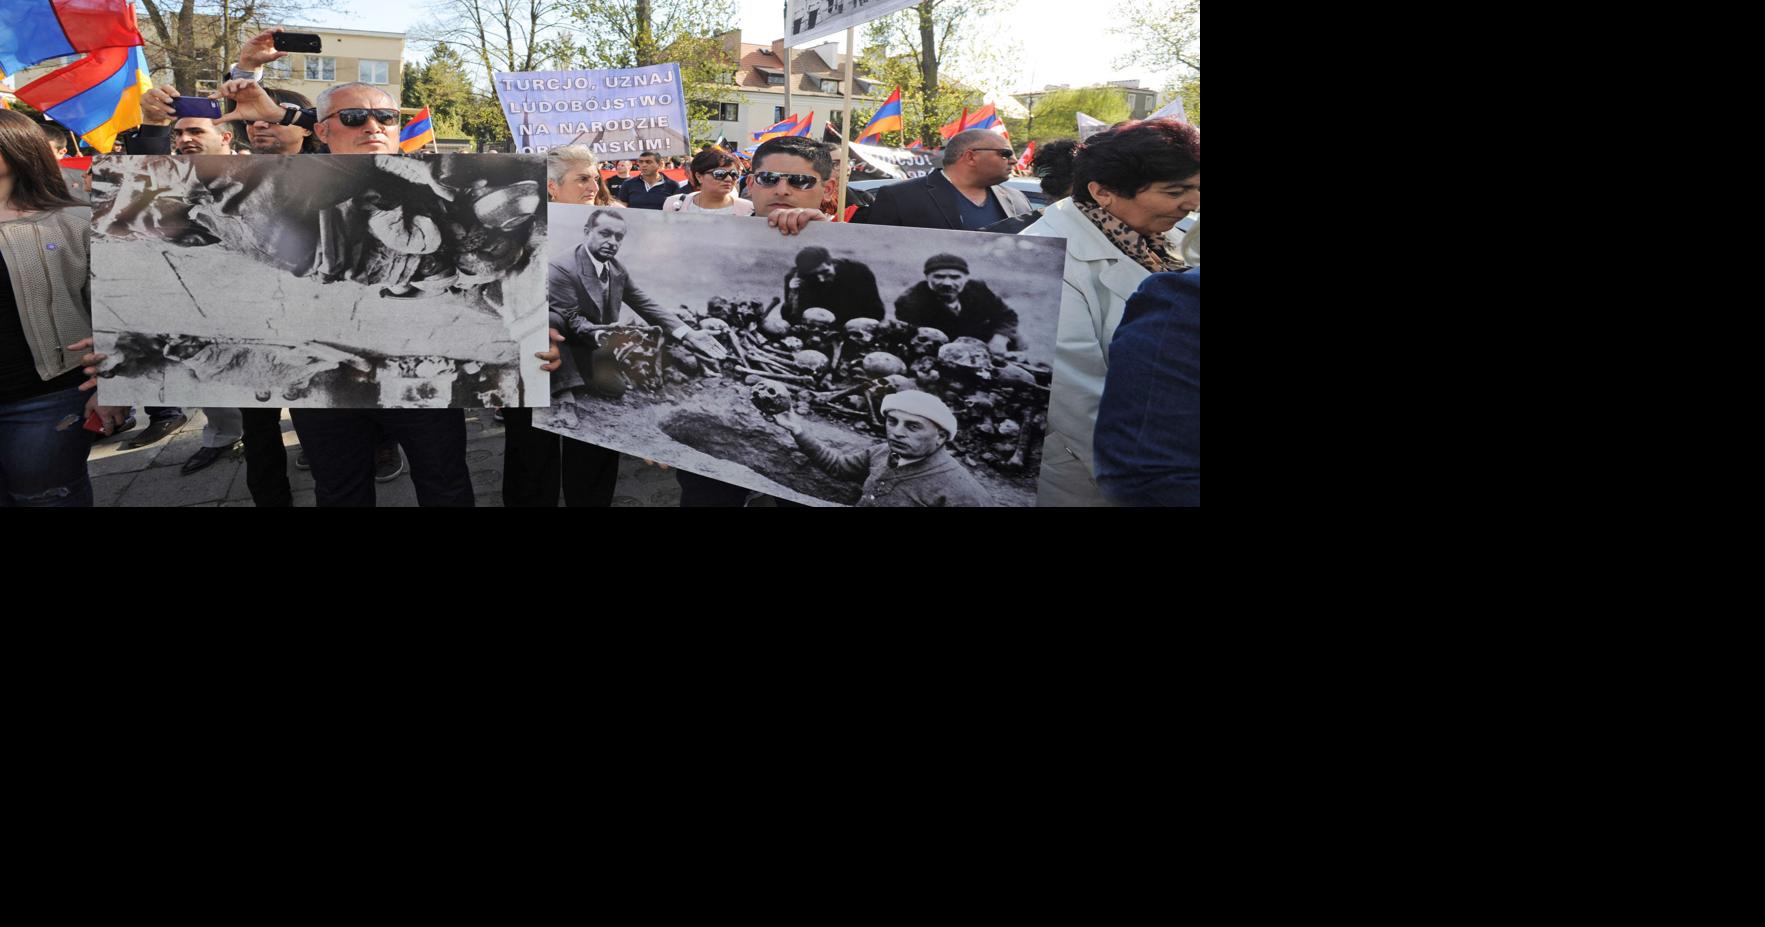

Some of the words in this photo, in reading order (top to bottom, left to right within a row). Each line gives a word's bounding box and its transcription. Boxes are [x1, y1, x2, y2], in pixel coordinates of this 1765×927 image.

[502, 77, 596, 92] TURCJO,
[605, 71, 673, 88] UZNAJ
[509, 94, 672, 113] LUDOBÓJSTWO
[519, 123, 550, 136] NA
[559, 116, 670, 135] NARODZIE
[521, 137, 672, 155] ORŃSKIM!
